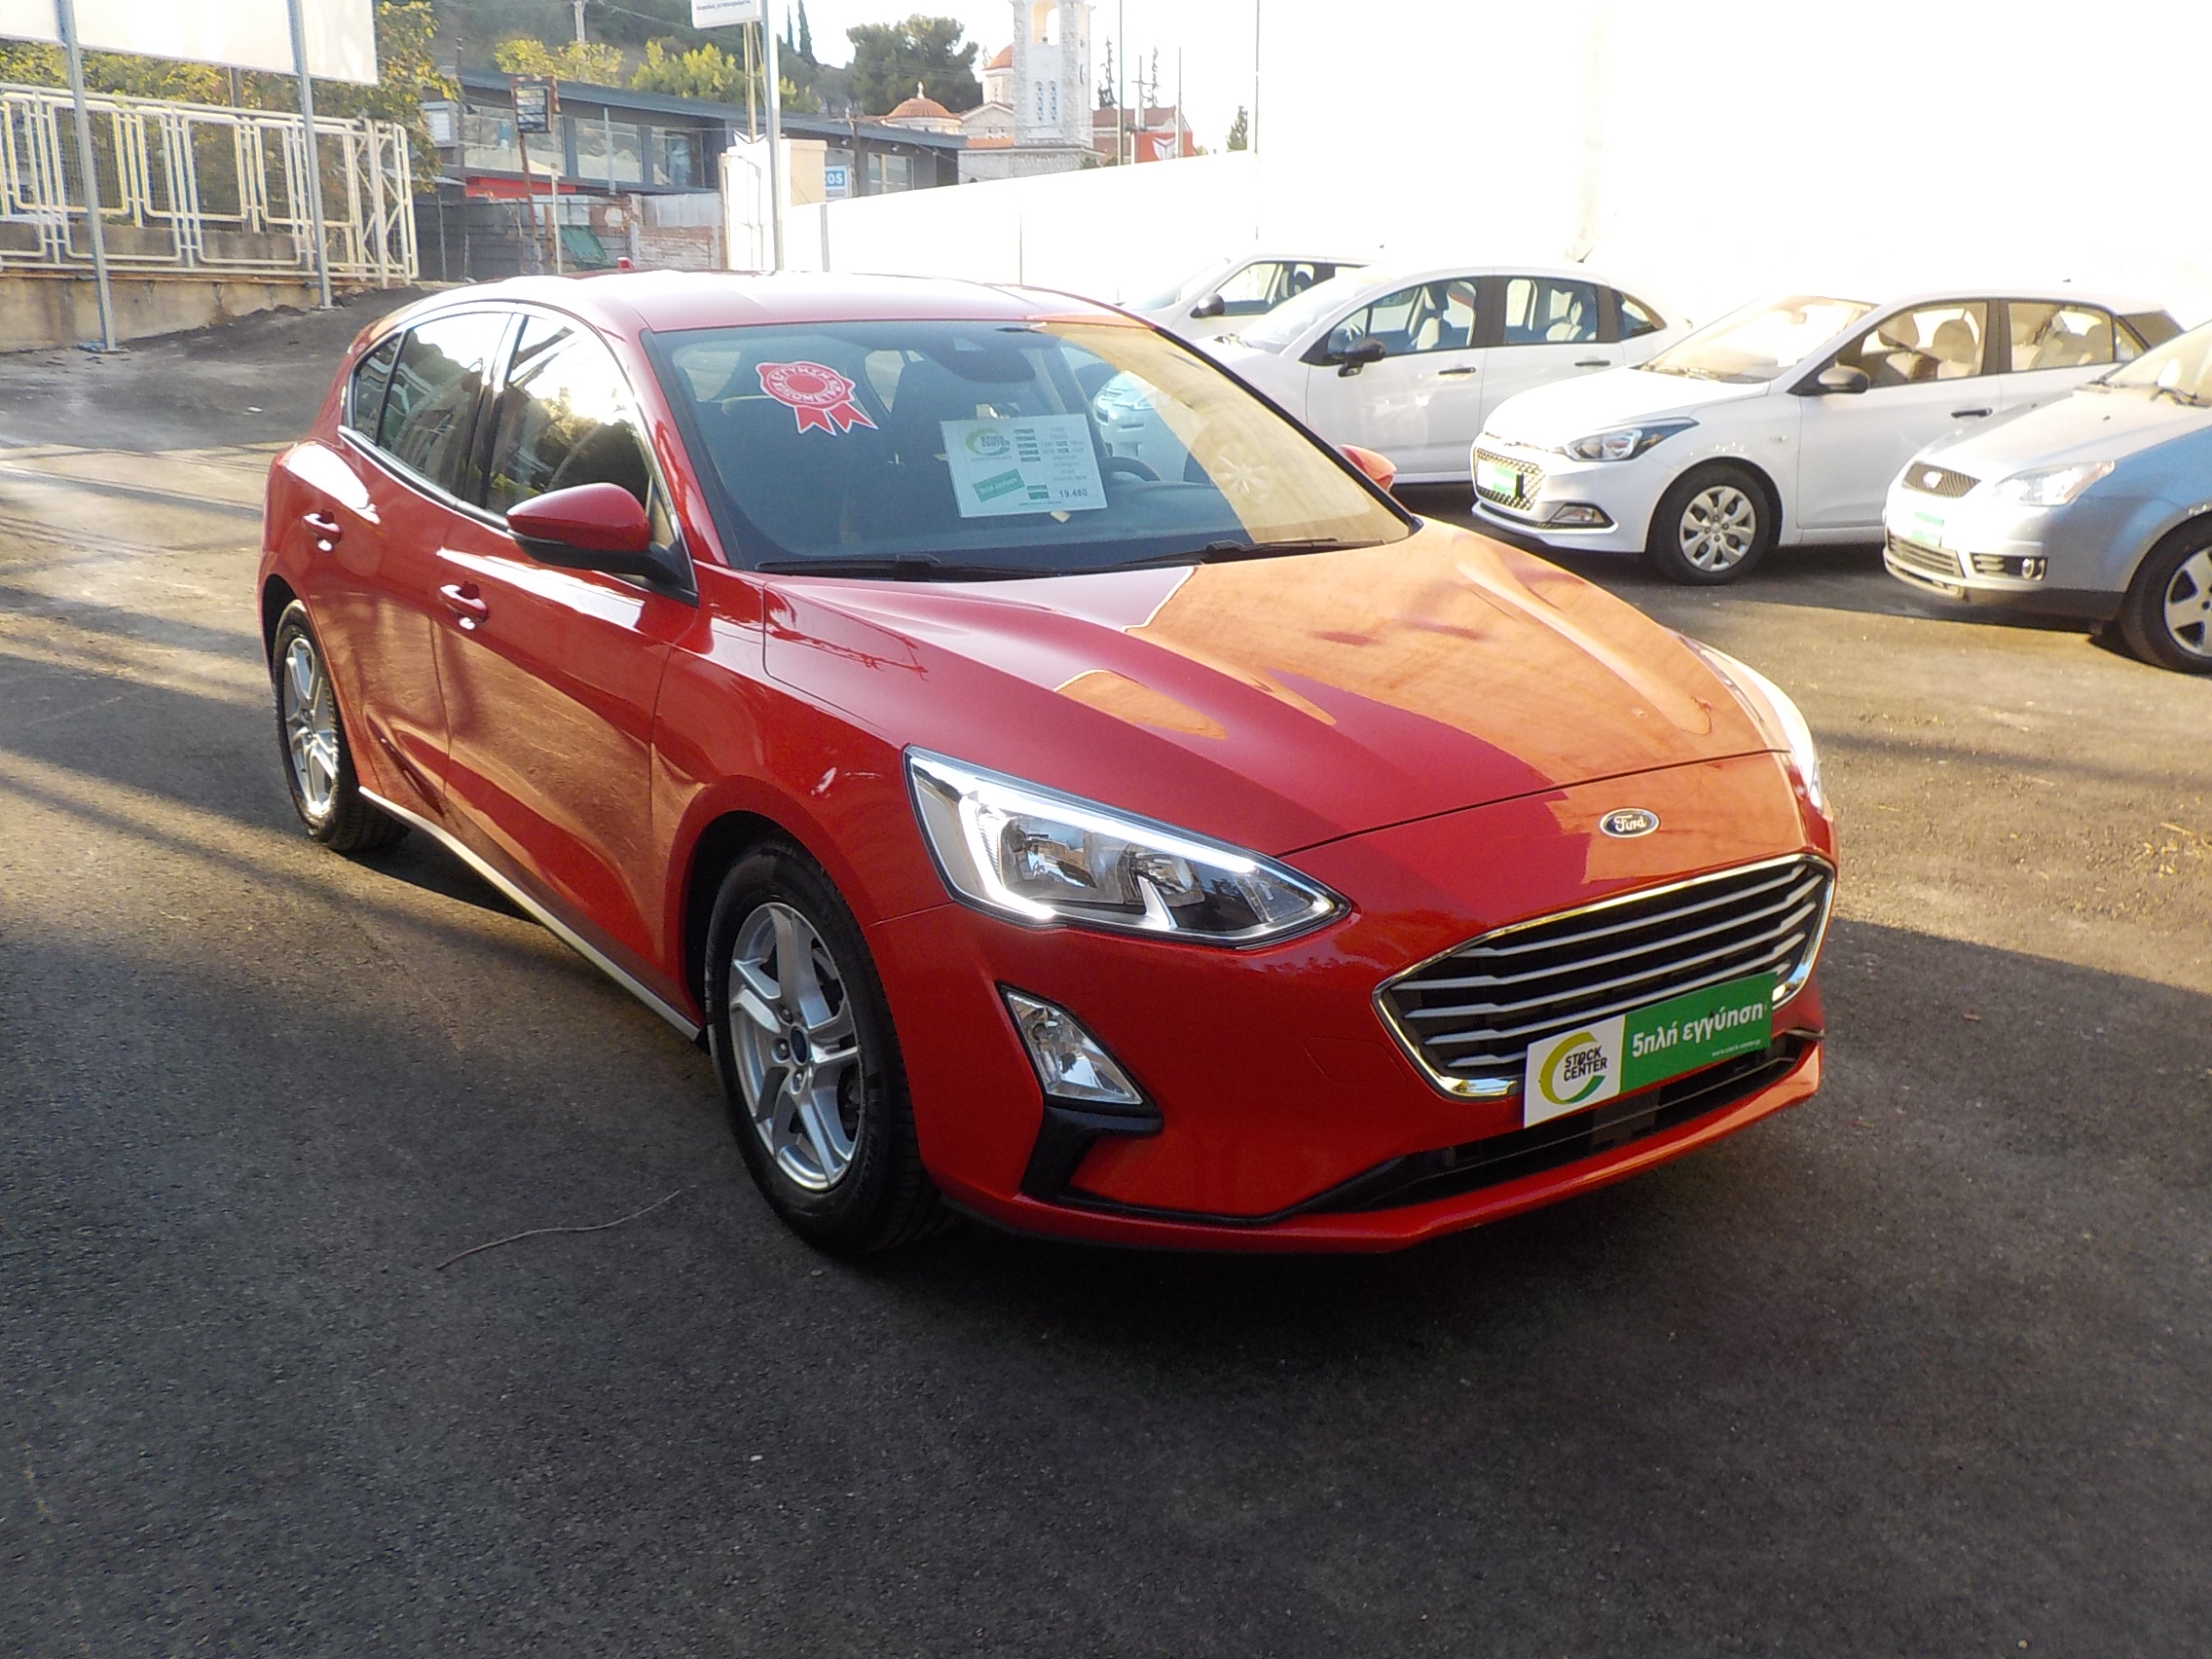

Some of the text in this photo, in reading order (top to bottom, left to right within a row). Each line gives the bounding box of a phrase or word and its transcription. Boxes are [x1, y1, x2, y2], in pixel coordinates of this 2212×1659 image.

[1058, 488, 1088, 498] 19.480
[1613, 814, 1647, 832] Ford
[1681, 1002, 1763, 1044] εγγύηση
[1565, 1046, 1602, 1068] STOCK
[1564, 1058, 1607, 1082] CENTER
